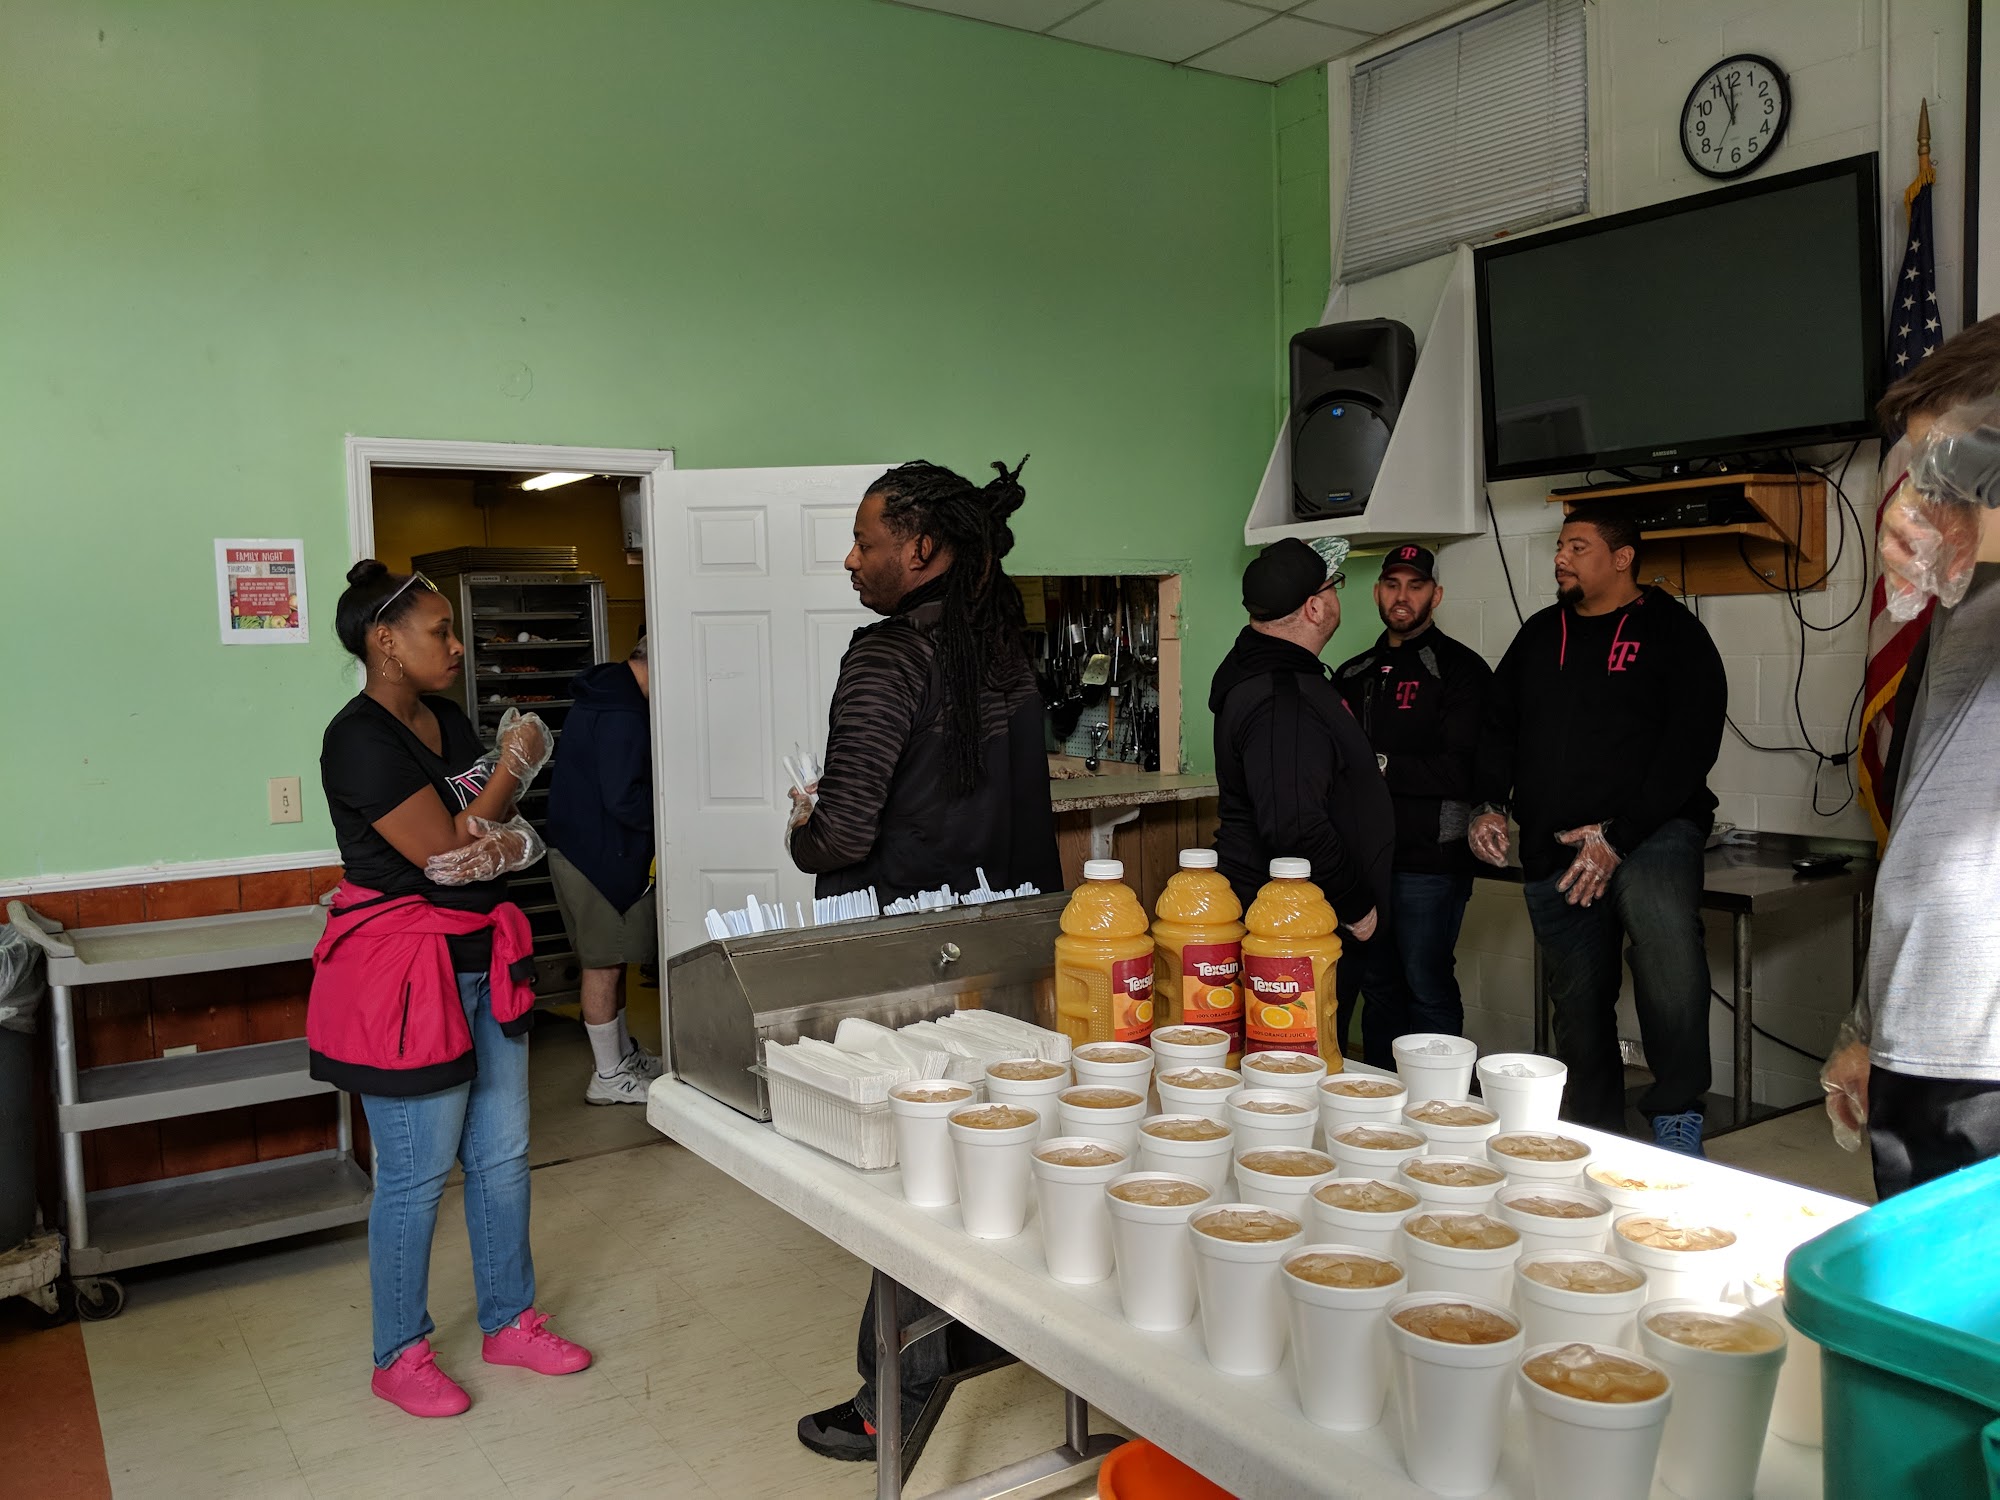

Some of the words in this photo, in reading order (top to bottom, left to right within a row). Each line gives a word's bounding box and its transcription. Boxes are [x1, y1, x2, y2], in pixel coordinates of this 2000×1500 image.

[1725, 70, 1741, 88] 12
[1747, 71, 1753, 87] 1
[1710, 82, 1722, 99] 11
[1758, 80, 1769, 98] 2
[1696, 99, 1712, 117] 10
[1764, 98, 1774, 115] 3
[1696, 120, 1706, 136] 9
[1760, 119, 1770, 135] 4
[1701, 138, 1711, 154] 8
[1748, 137, 1758, 153] 5
[1713, 146, 1723, 163] 7
[1731, 147, 1741, 163] 6
[1652, 449, 1677, 457] SAMSUNG
[236, 552, 258, 561] FAMILY
[262, 552, 283, 561] NIGHT
[1401, 546, 1417, 560] T
[227, 565, 252, 573] THURSDAY
[1608, 641, 1640, 671] T
[1396, 680, 1419, 709] T
[1193, 961, 1238, 977] Texsun
[1122, 972, 1154, 992] Texsu
[1249, 975, 1300, 993] Texsun
[620, 1080, 637, 1093] N
